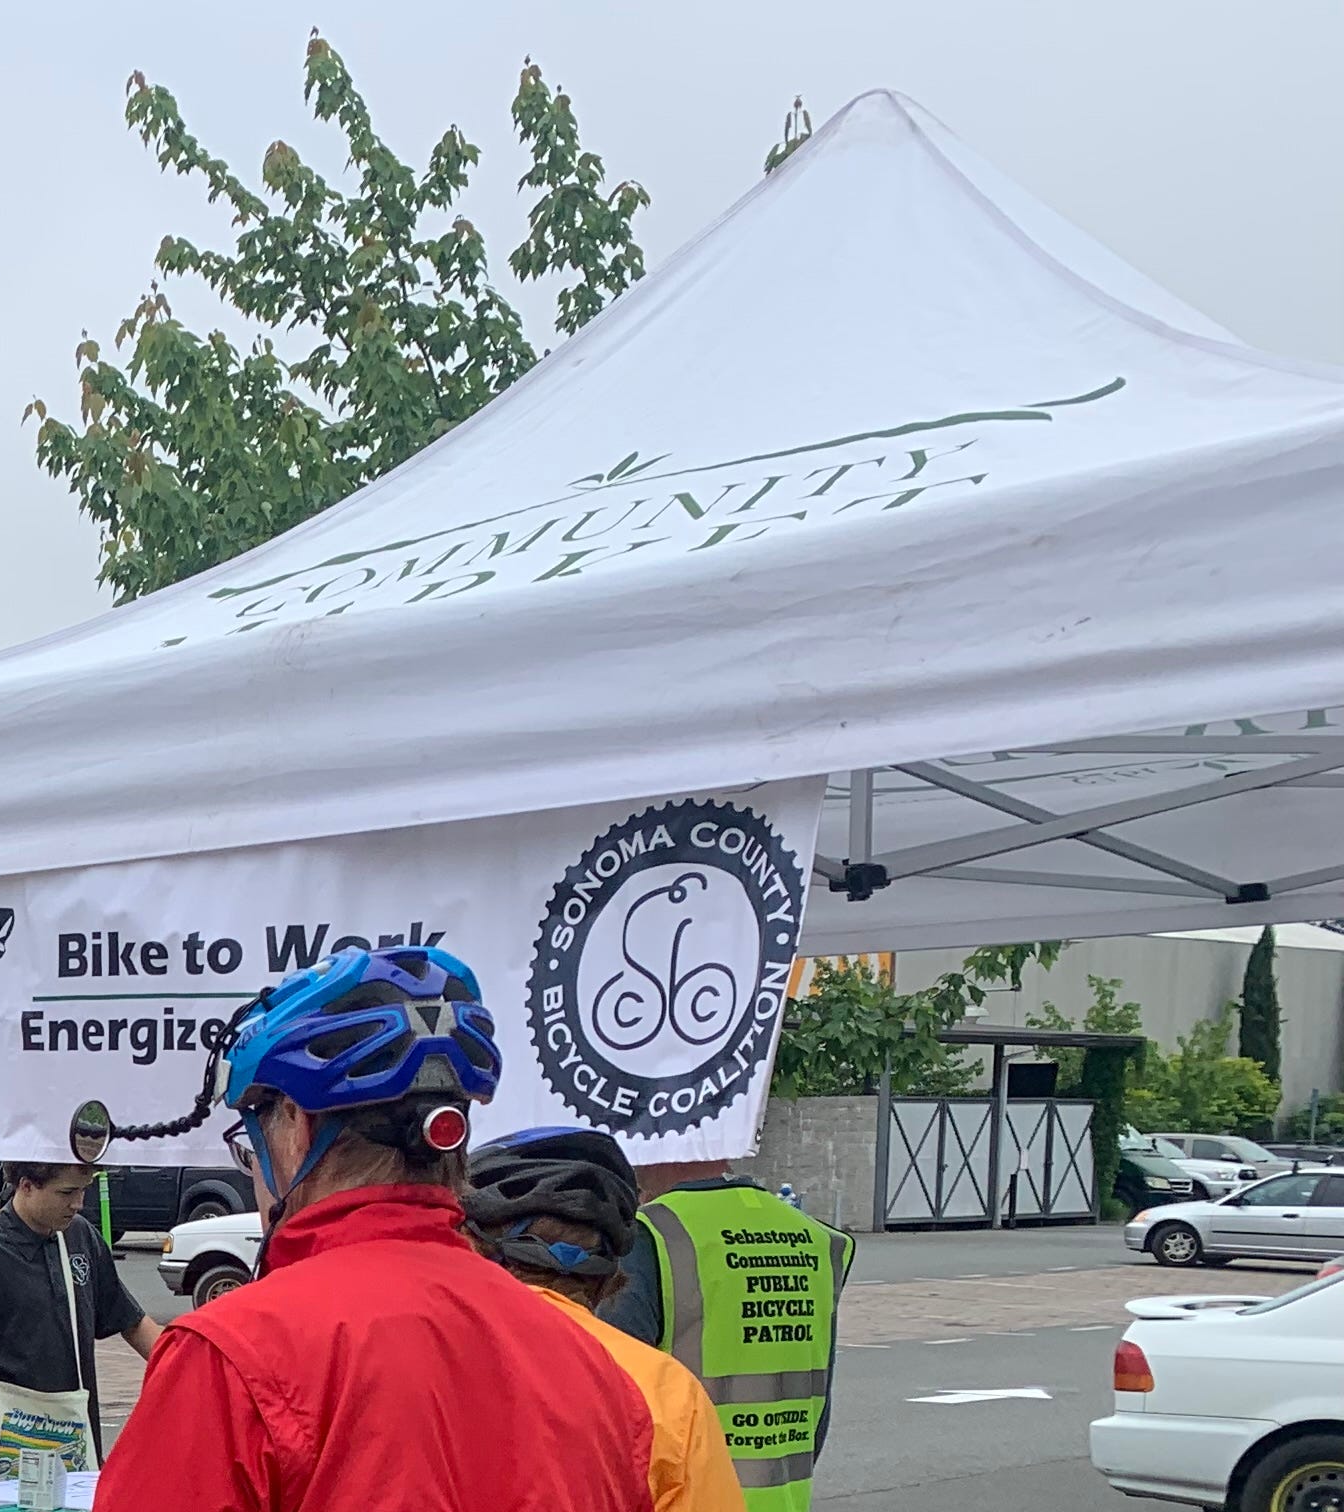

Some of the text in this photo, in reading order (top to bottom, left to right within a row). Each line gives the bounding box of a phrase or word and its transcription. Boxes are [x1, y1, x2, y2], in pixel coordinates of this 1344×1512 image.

[235, 438, 978, 618] COMMUNITY
[551, 821, 794, 952] SONOMA COUNTY
[58, 930, 170, 977] Bike
[183, 933, 244, 973] to
[543, 961, 791, 1118] BICYCLE COALITION
[721, 1229, 813, 1248] Sebastopol
[726, 1252, 819, 1272] Community
[746, 1275, 809, 1293] PUBLIC
[741, 1299, 814, 1319] BICYCLE
[743, 1324, 813, 1343] PATROL
[732, 1410, 809, 1428] GO OUTSIDE
[725, 1432, 778, 1450] Forget
